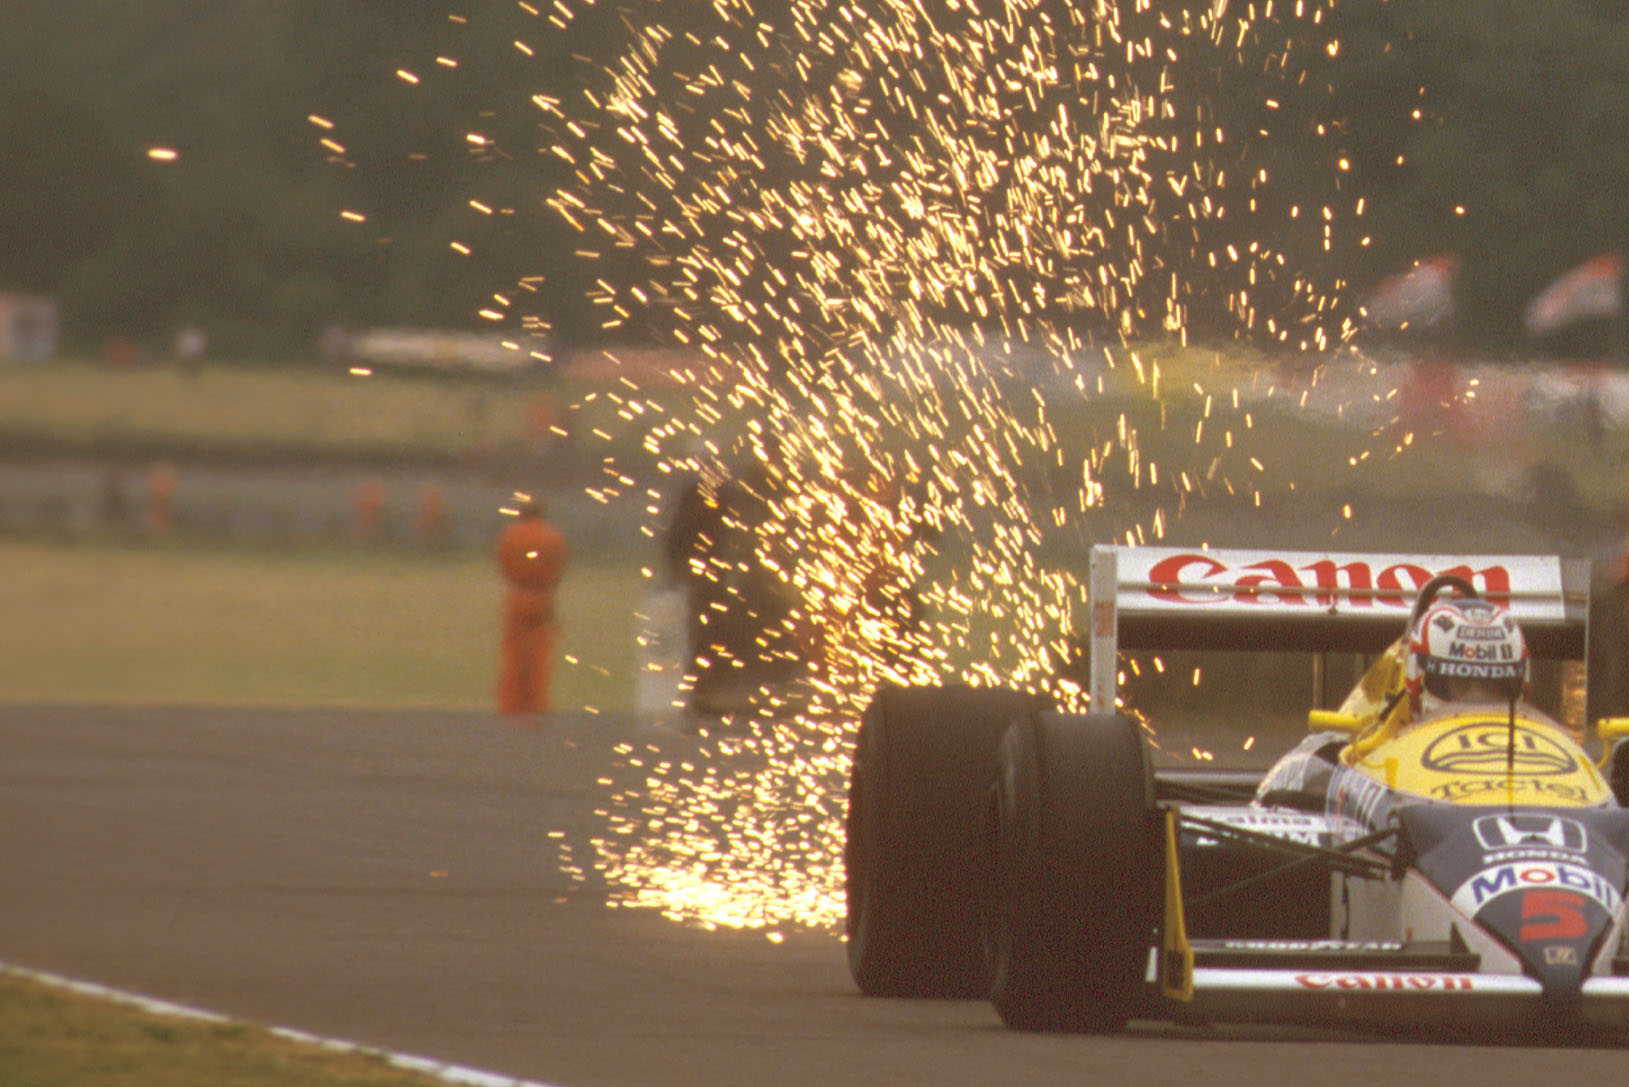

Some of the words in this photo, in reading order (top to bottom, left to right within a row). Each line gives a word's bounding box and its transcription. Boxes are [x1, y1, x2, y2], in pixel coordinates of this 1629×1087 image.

[1147, 553, 1511, 610] Canon
[1449, 643, 1497, 660] Mobil
[1439, 662, 1516, 678] HONDA
[1456, 732, 1538, 751] ICI
[1431, 779, 1588, 801] Tactel
[1470, 866, 1614, 908] Mobil
[1519, 890, 1588, 942] 5
[1294, 974, 1473, 990] Canon
